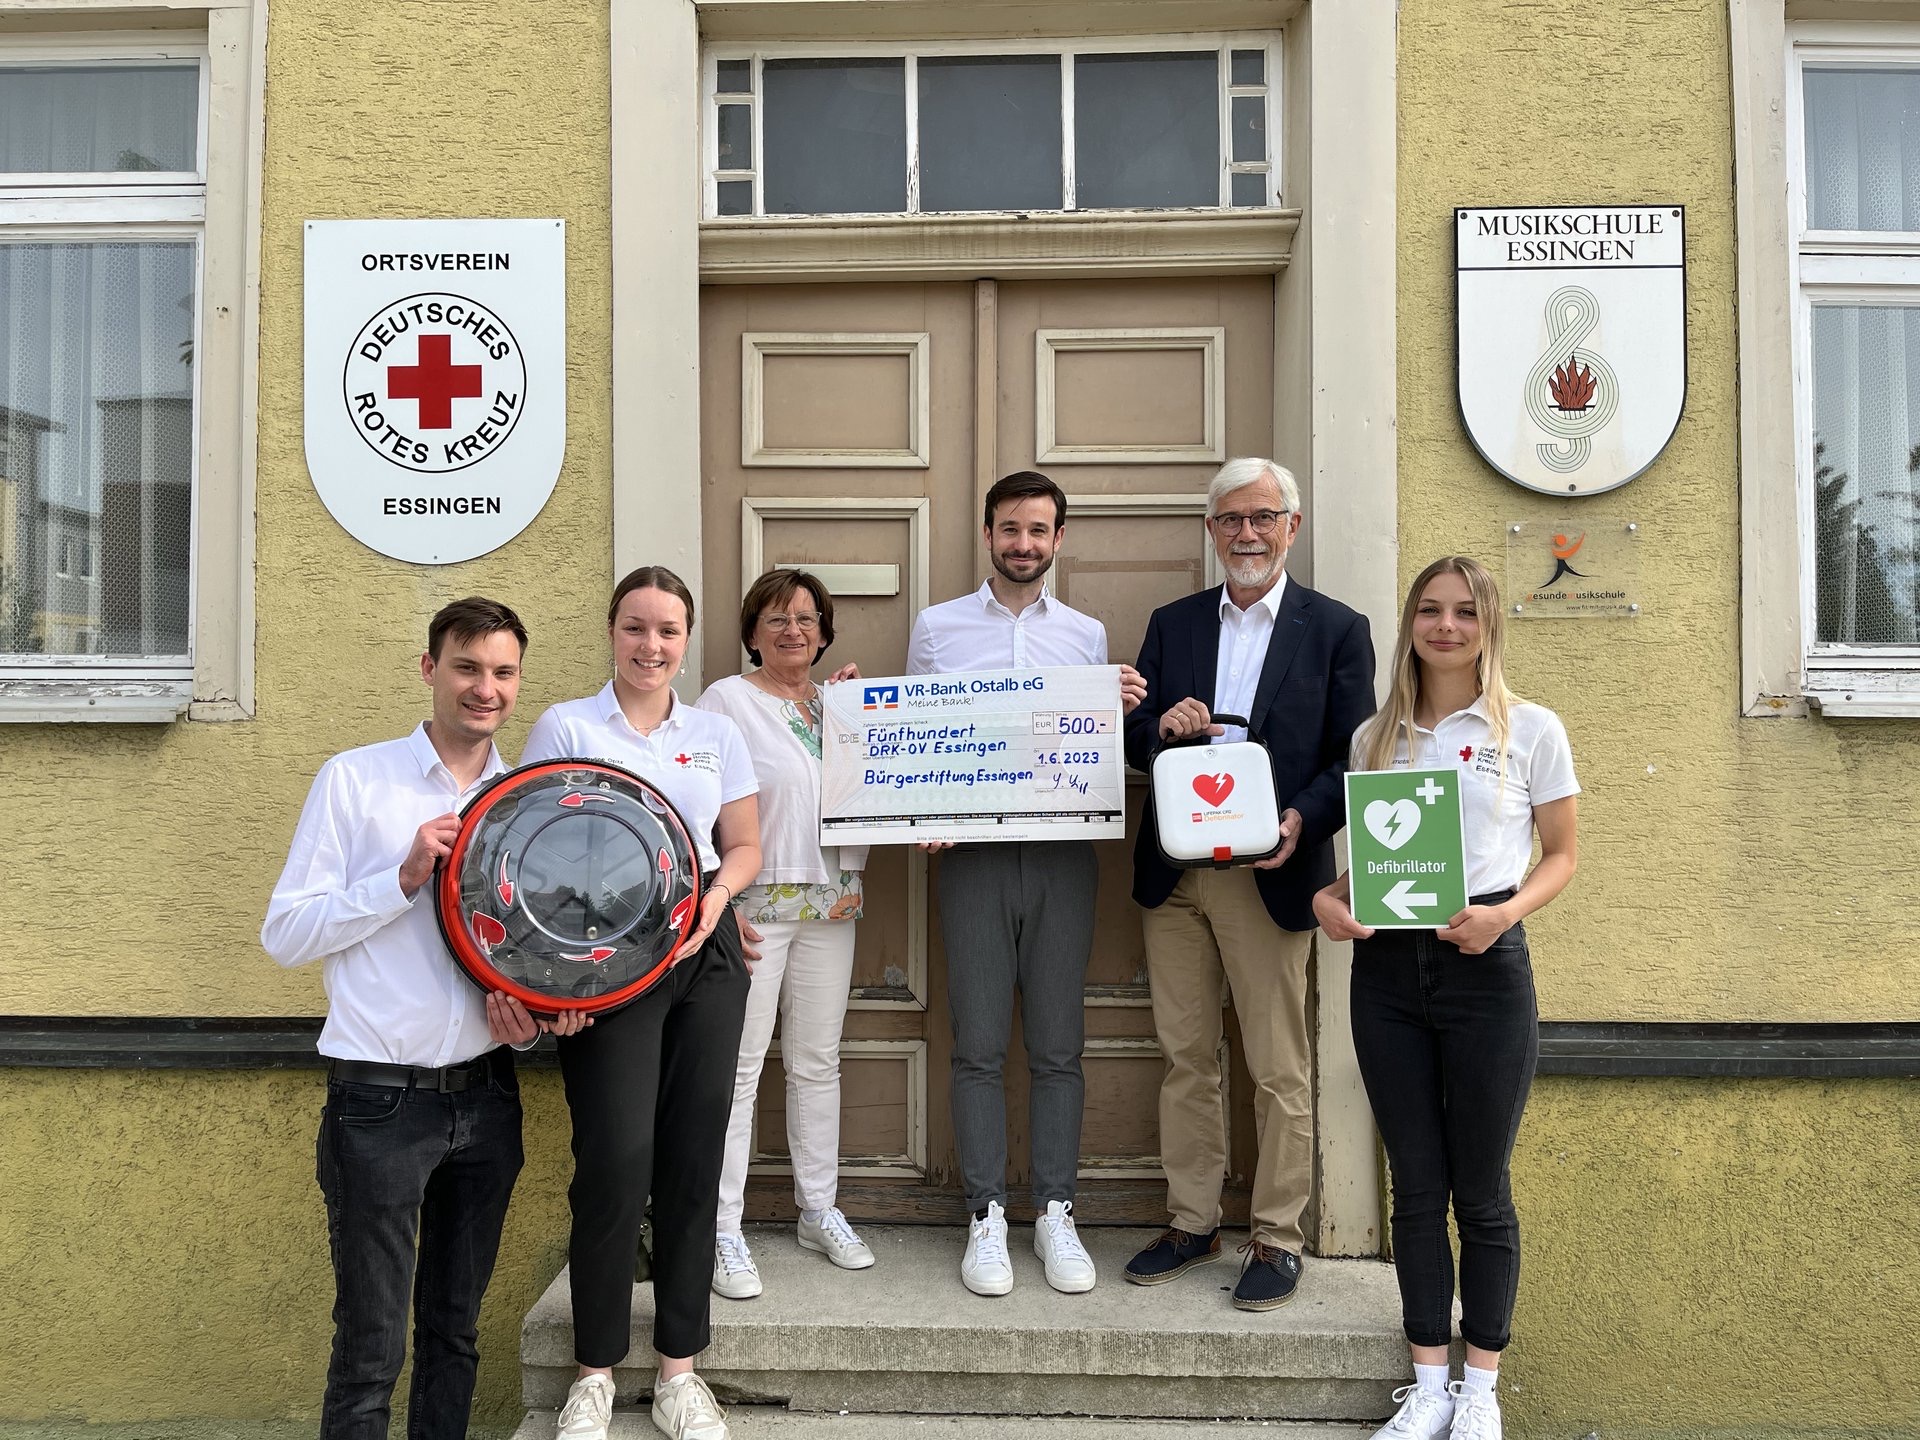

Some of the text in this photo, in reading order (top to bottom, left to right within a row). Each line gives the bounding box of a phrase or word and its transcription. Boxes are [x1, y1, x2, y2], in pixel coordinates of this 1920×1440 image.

[1477, 213, 1664, 236] MUSIKSCHULE
[1506, 239, 1635, 262] ESSINGEN
[361, 253, 510, 271] ORTSVEREIN
[360, 303, 510, 362] DEUTSCHES
[354, 390, 517, 464] ROTES KREUZ
[383, 497, 501, 515] ESSINGEN
[904, 676, 1044, 697] VR-Bank Ostalb eG
[907, 696, 975, 708] Meine Bank!
[867, 723, 976, 743] Fünfhundert
[1059, 717, 1106, 734] 500.-
[838, 733, 860, 744] DE
[869, 740, 1006, 757] DRK-OV Essingen
[863, 770, 974, 789] Bürgerstiftung
[976, 769, 1033, 785] Essingen
[1367, 860, 1447, 874] Defibrillator
